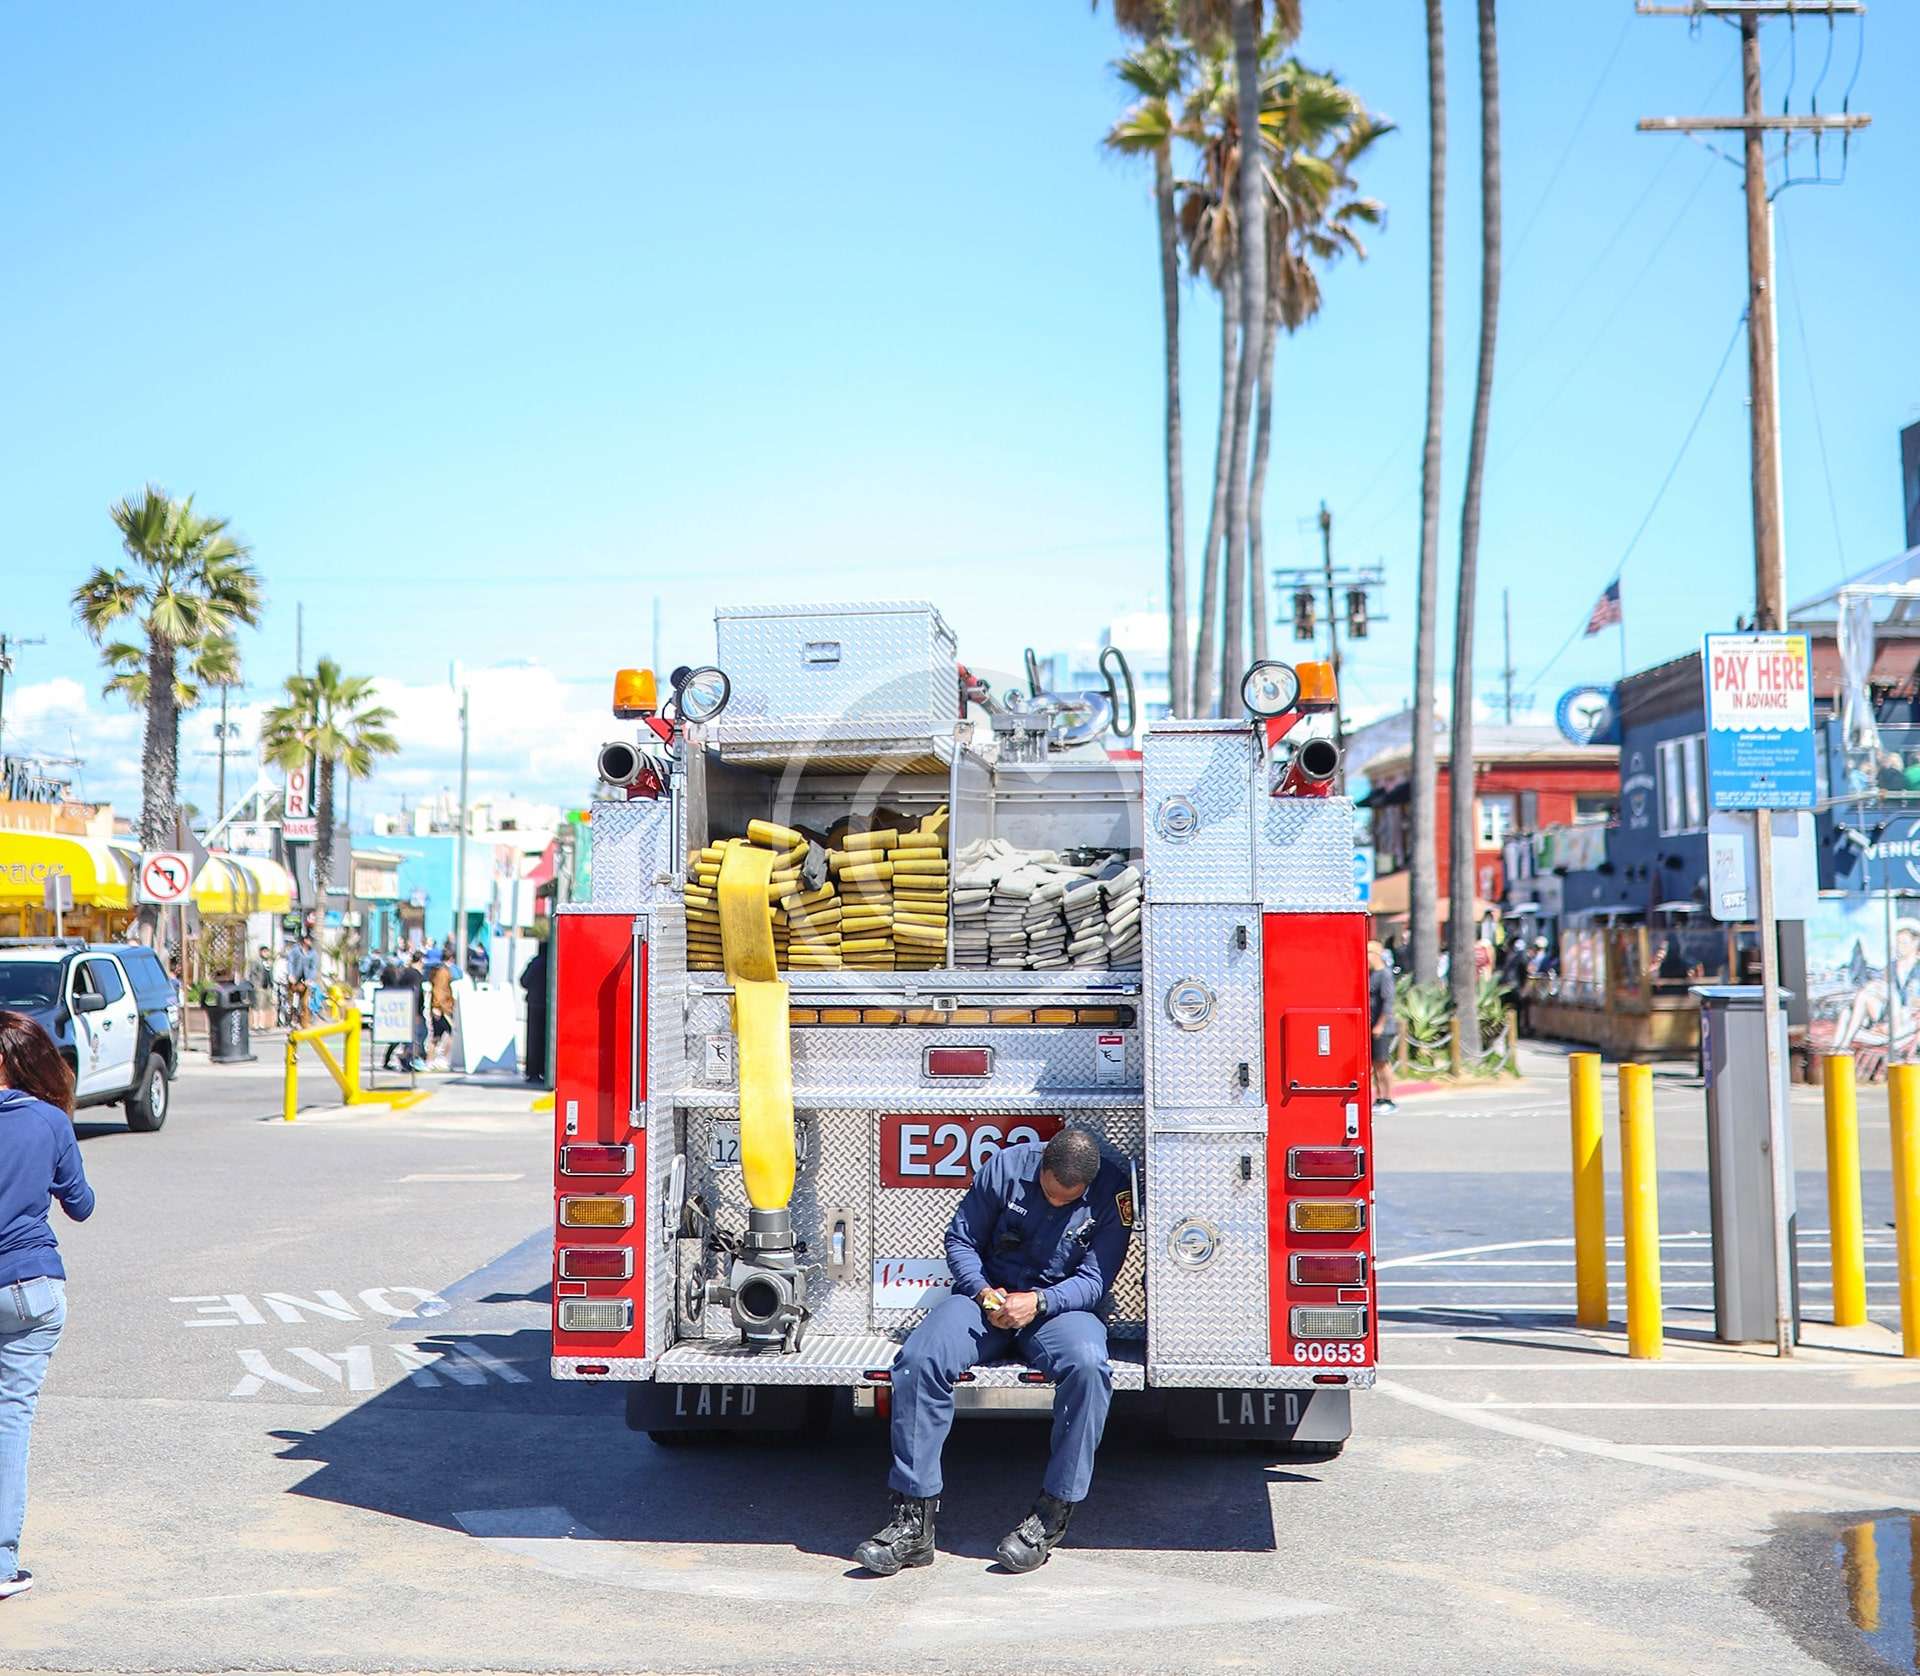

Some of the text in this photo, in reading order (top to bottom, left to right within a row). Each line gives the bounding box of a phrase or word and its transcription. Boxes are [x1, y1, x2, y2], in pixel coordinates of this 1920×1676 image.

[1714, 656, 1805, 691] PAY HERE
[1733, 692, 1788, 709] IN ADVANCE
[881, 1263, 955, 1289] Venice
[169, 1286, 449, 1328] ONE
[1294, 1342, 1366, 1363] 60653
[228, 1342, 533, 1397] WAY
[675, 1384, 756, 1416] LAFD
[1216, 1392, 1300, 1425] LAFD
